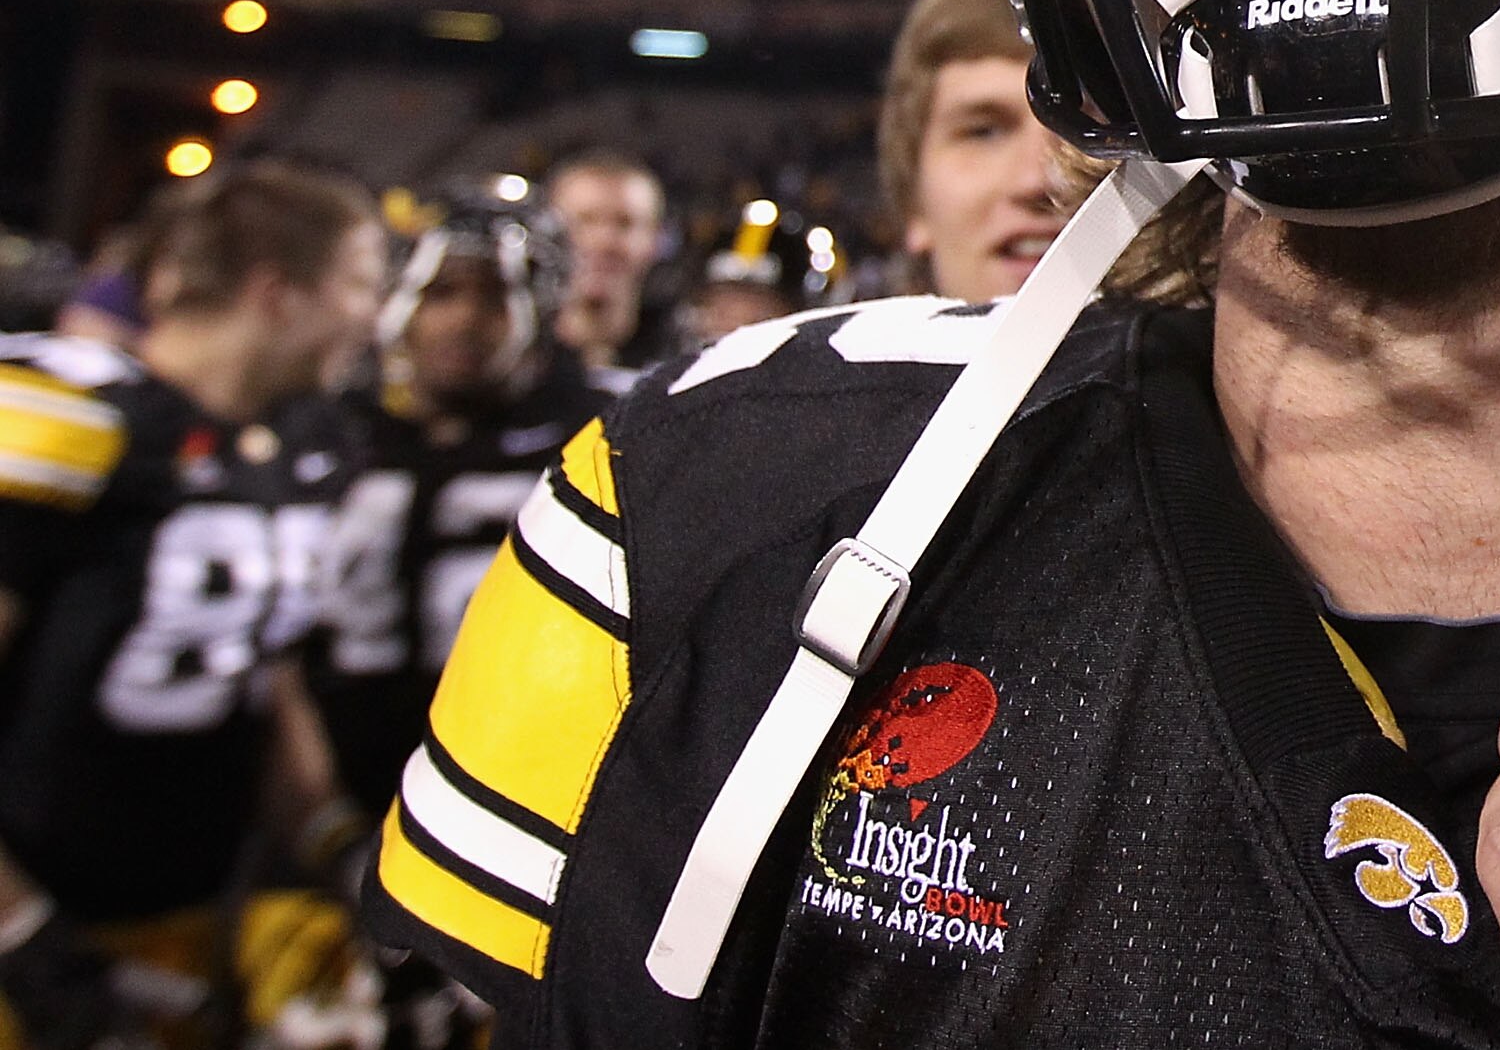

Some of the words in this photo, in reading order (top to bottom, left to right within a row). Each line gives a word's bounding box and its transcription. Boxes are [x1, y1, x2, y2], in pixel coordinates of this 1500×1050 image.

[845, 790, 977, 904] Insight
[885, 901, 1005, 955] ARIZONA
[924, 887, 1009, 927] BOWL
